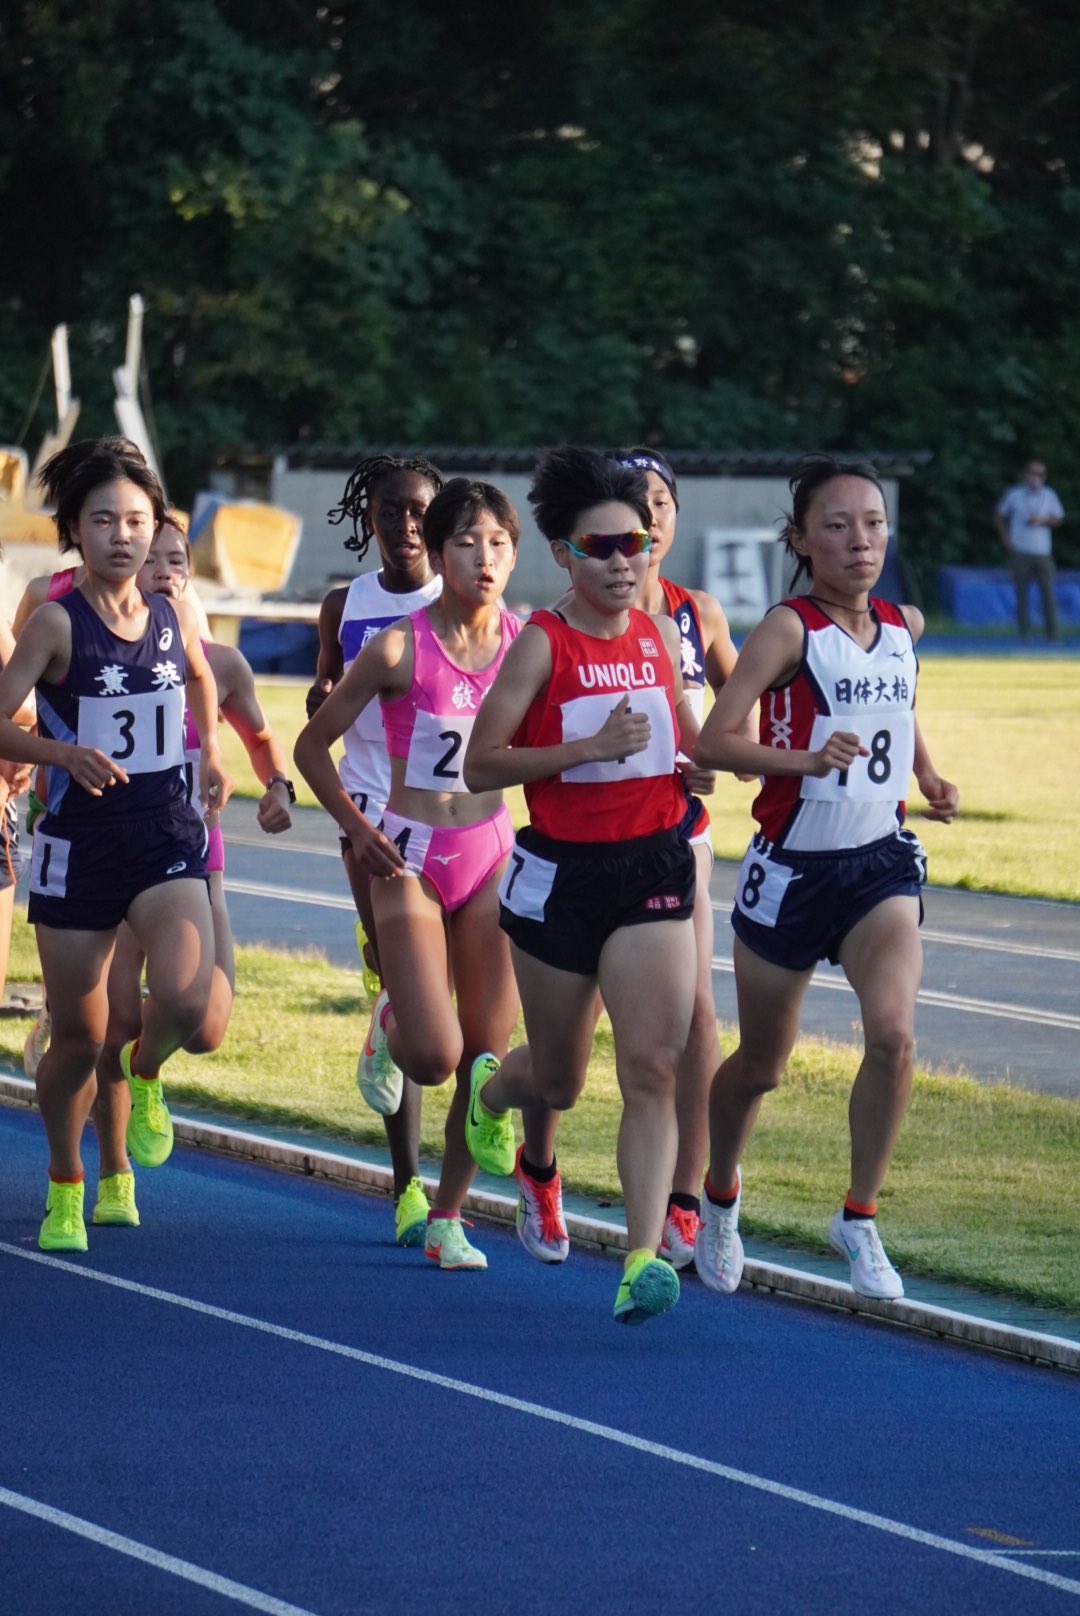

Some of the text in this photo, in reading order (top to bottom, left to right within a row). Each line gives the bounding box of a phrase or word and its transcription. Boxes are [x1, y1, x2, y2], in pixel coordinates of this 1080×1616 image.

[578, 661, 656, 691] UNIQLO
[835, 674, 908, 705] 日体大柏
[111, 704, 165, 760] 31
[838, 729, 891, 787] 8
[506, 850, 525, 900] 7
[742, 863, 766, 909] 8
